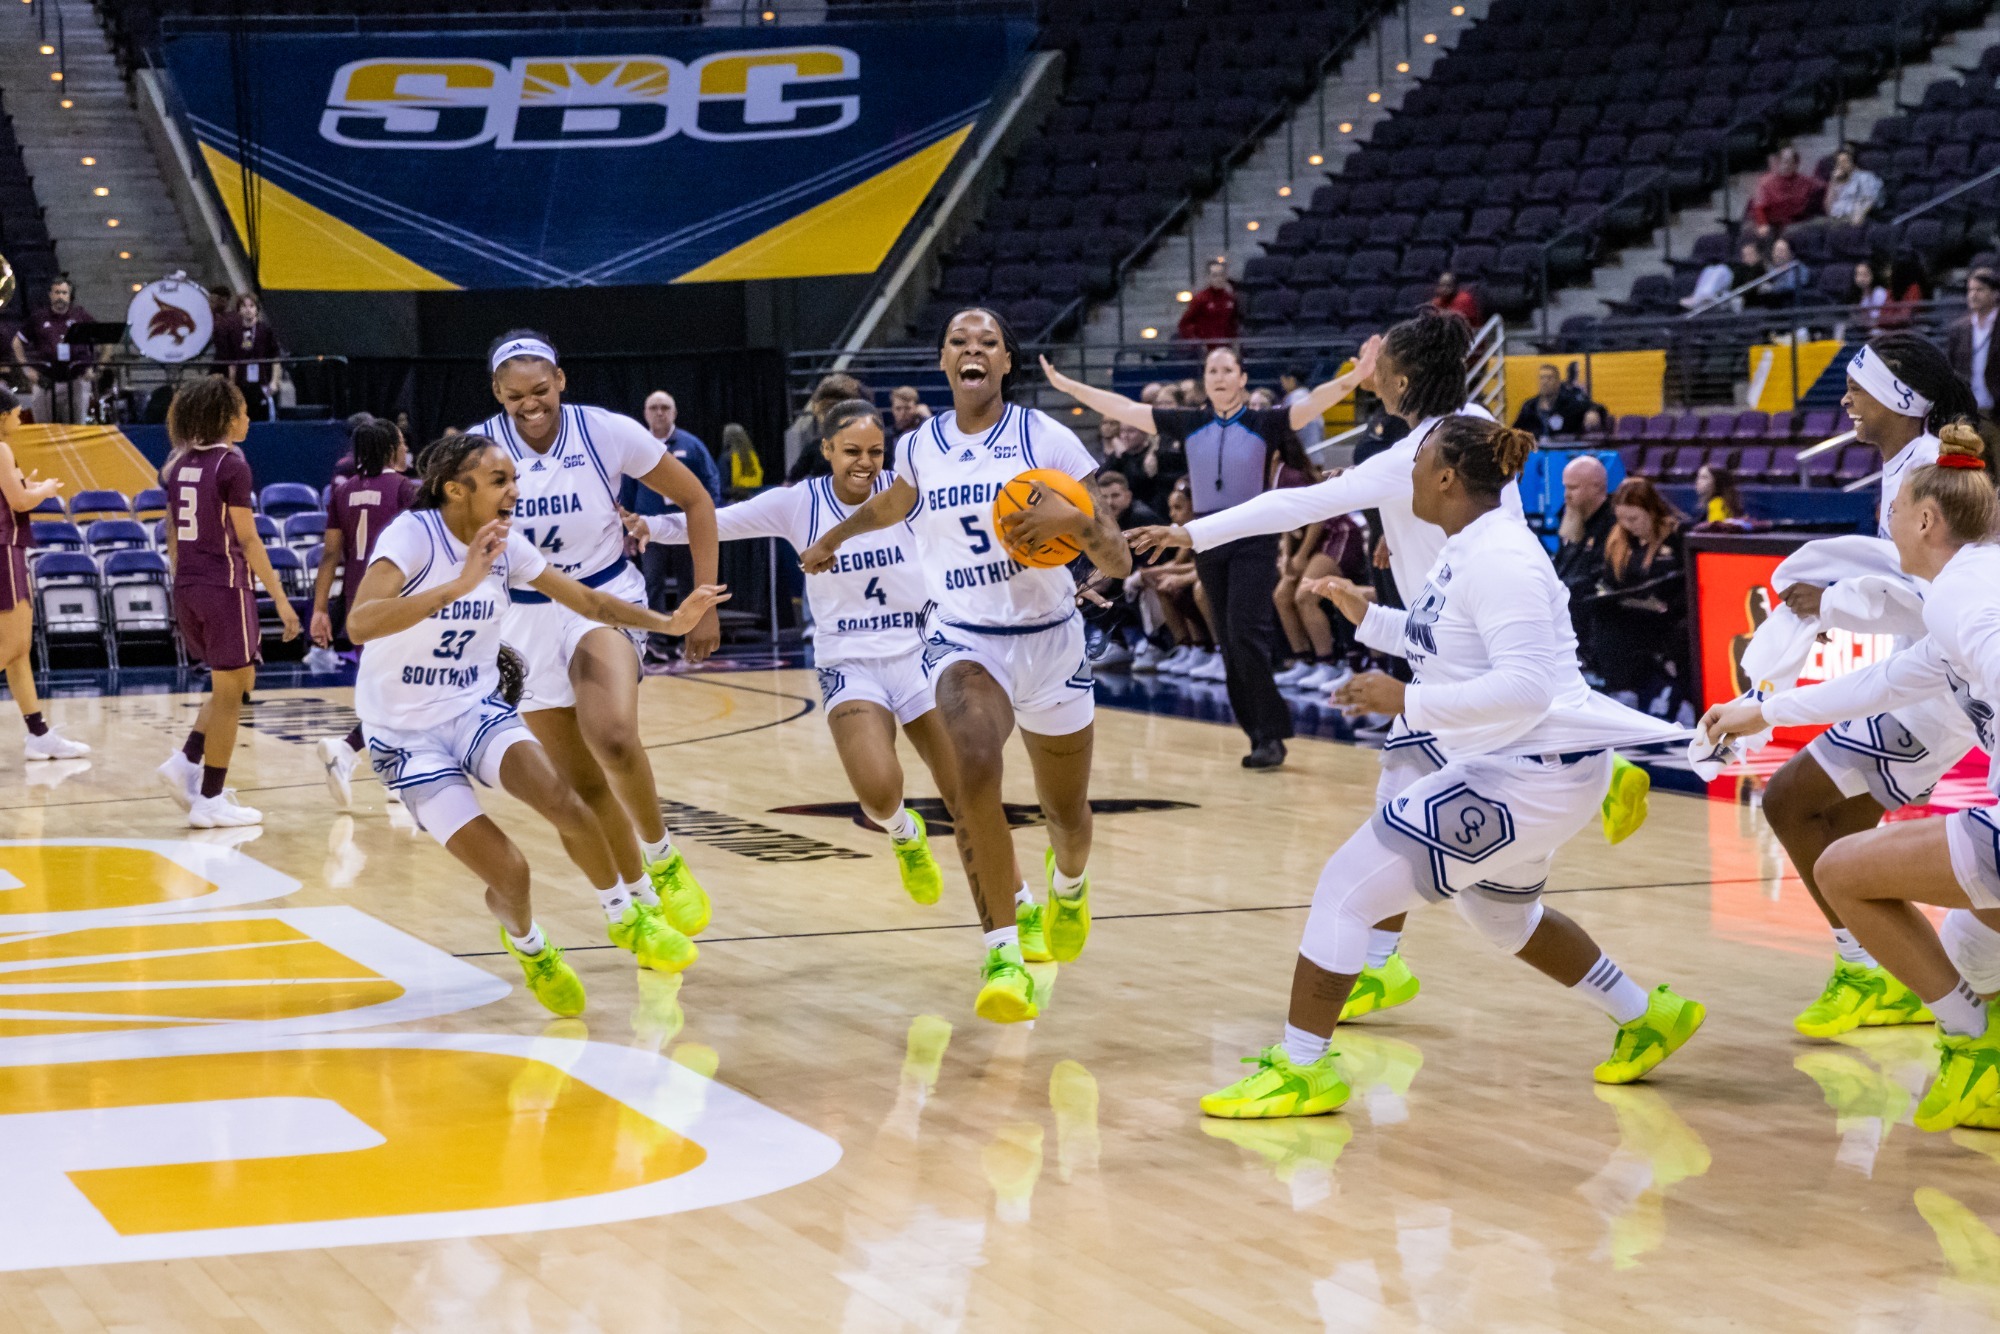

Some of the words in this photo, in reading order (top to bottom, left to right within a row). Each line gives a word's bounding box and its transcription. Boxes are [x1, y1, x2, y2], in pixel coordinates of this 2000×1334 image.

[318, 45, 861, 150] SBC
[563, 454, 586, 469] SBC
[177, 486, 199, 542] 3
[514, 492, 583, 518] EORGIA
[356, 508, 369, 561] 1
[523, 525, 564, 553] 14
[959, 515, 991, 555] 5
[864, 576, 887, 606] 4
